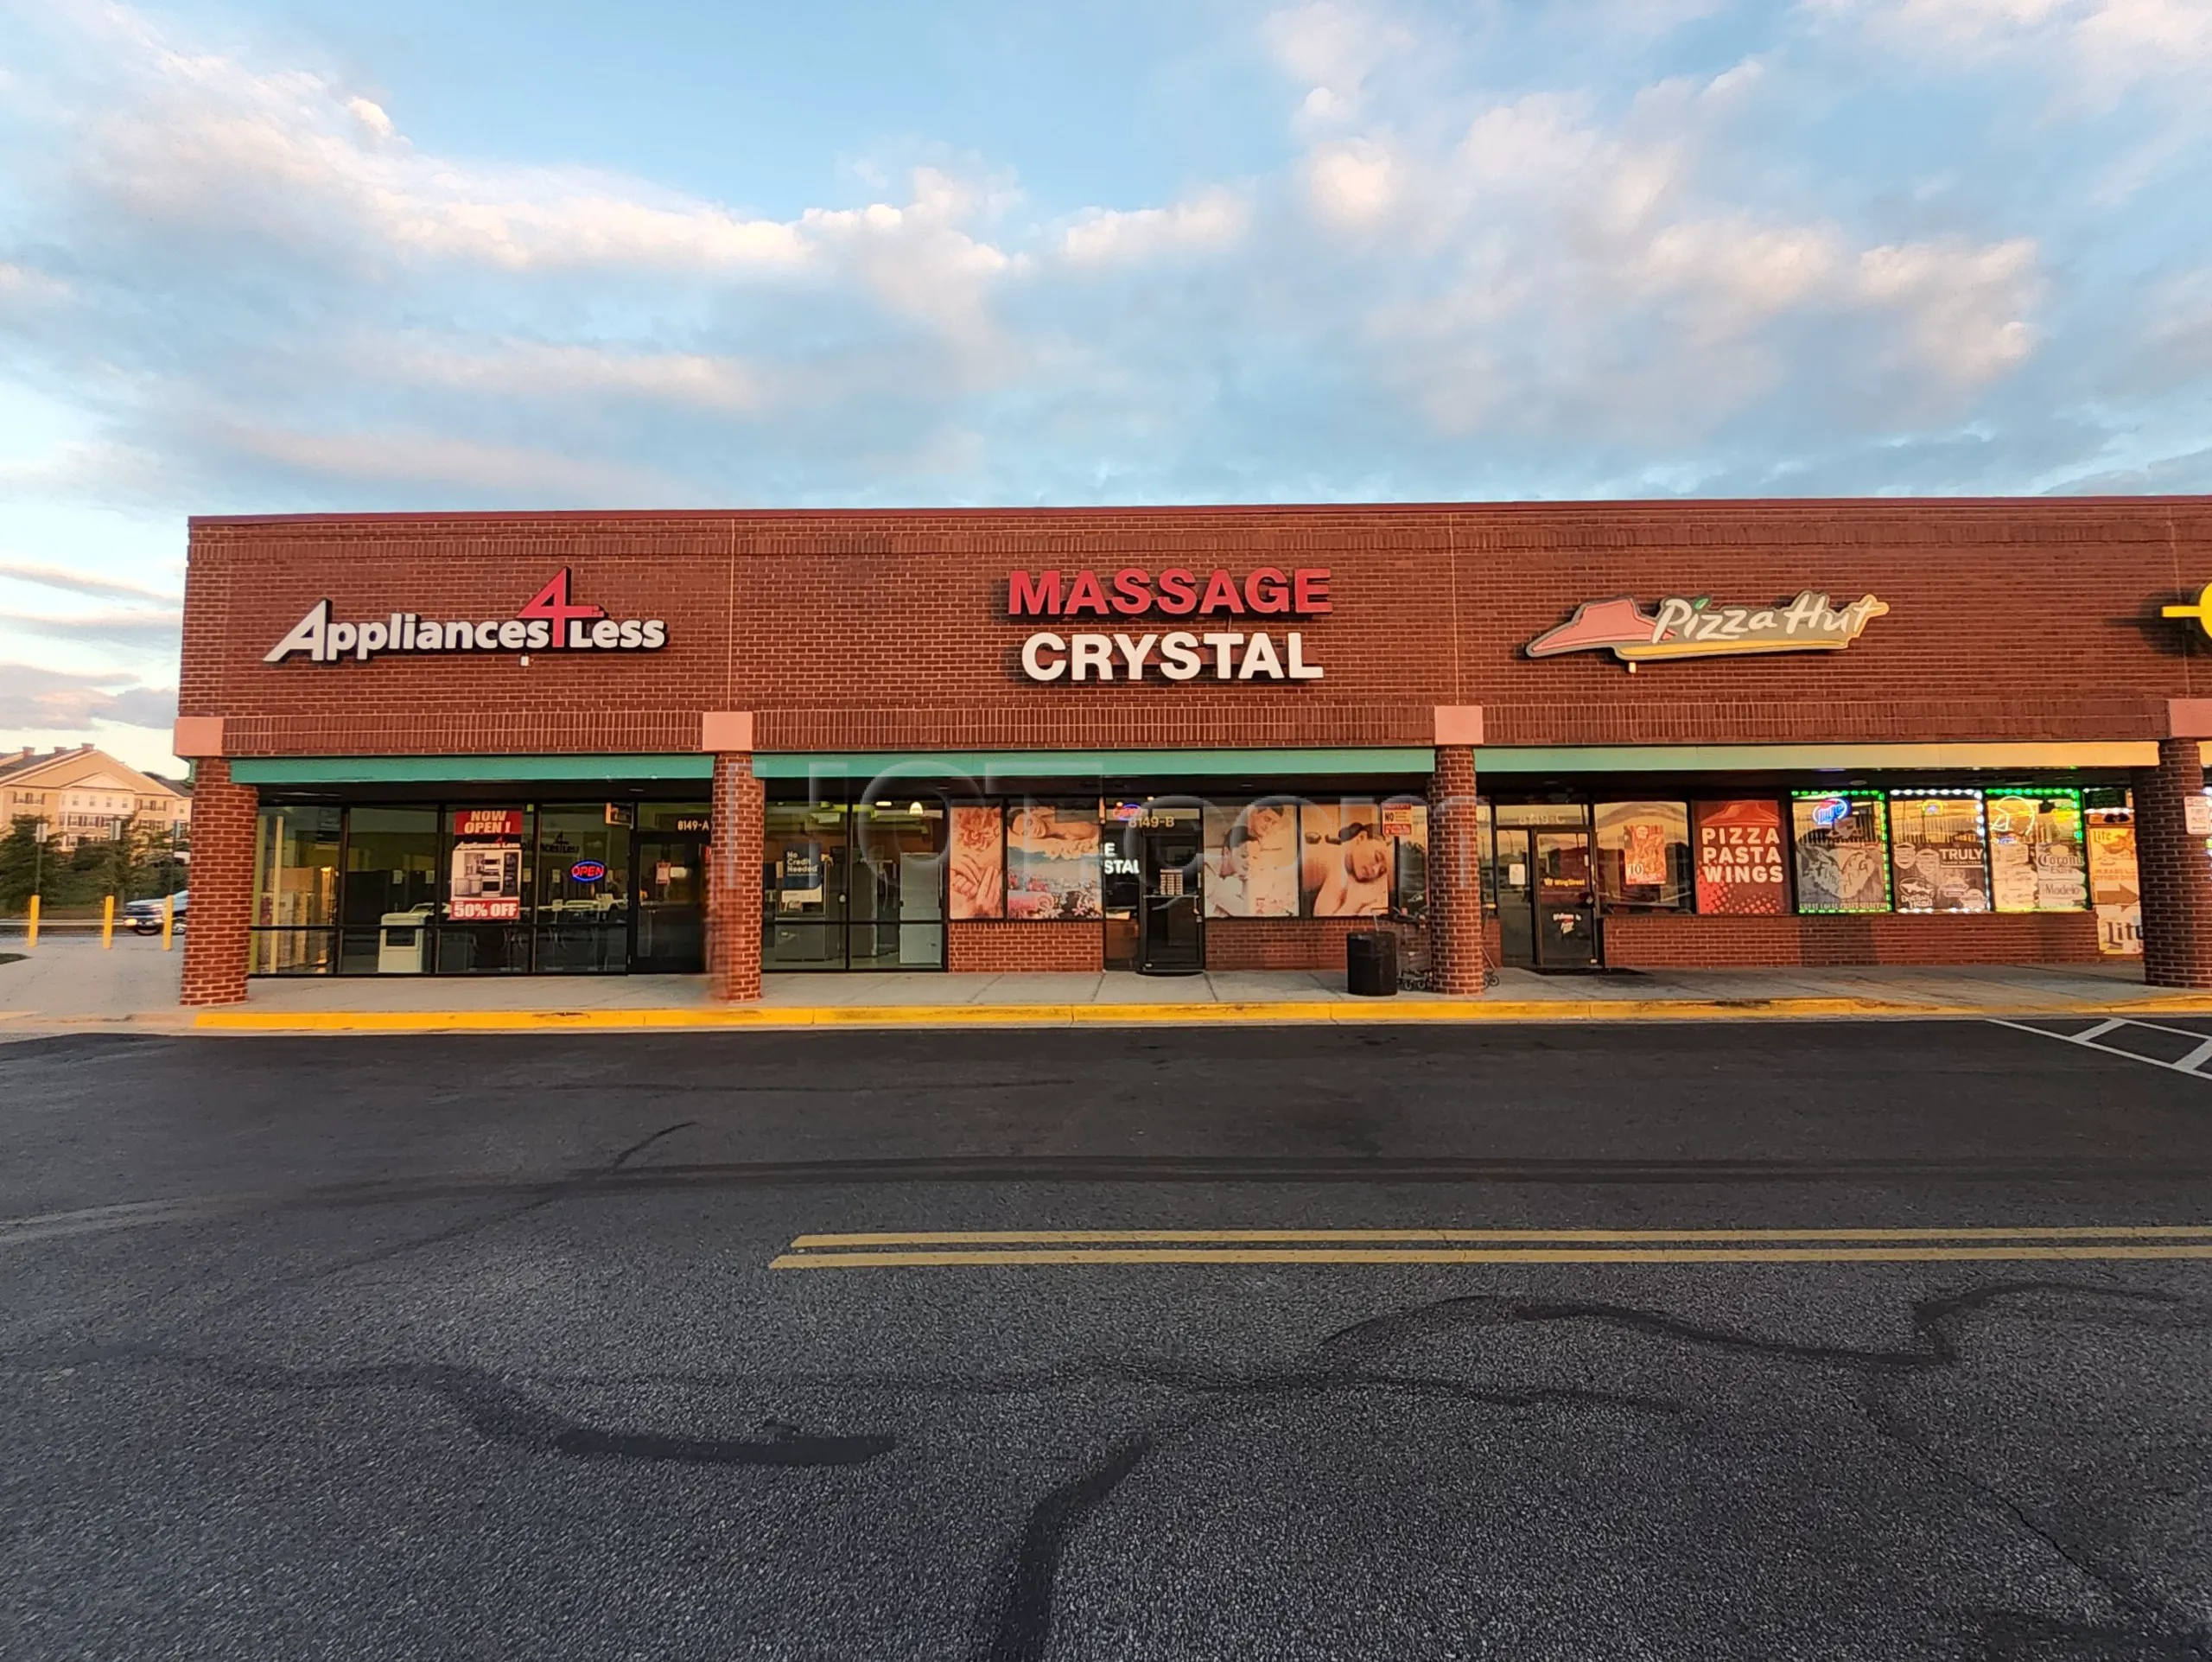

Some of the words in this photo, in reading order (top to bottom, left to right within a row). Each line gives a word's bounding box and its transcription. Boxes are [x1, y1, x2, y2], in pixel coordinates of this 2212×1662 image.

[1007, 567, 1332, 615] MASSAGE
[1650, 596, 1778, 644] Pizza
[1782, 593, 1877, 635] Hut
[1021, 632, 1325, 681] CRYSTAL
[470, 810, 507, 821] NOW
[1128, 816, 1175, 829] 8149-B
[677, 820, 709, 831] 8149-A
[1702, 827, 1781, 845] PIZZA
[1703, 846, 1782, 864] PASTA
[1939, 848, 1984, 860] TRULY
[571, 866, 604, 877] OPEN
[1703, 865, 1783, 883] WINGS
[2045, 883, 2080, 895] Modelo
[454, 903, 488, 918] 50%
[490, 902, 518, 917] OFF
